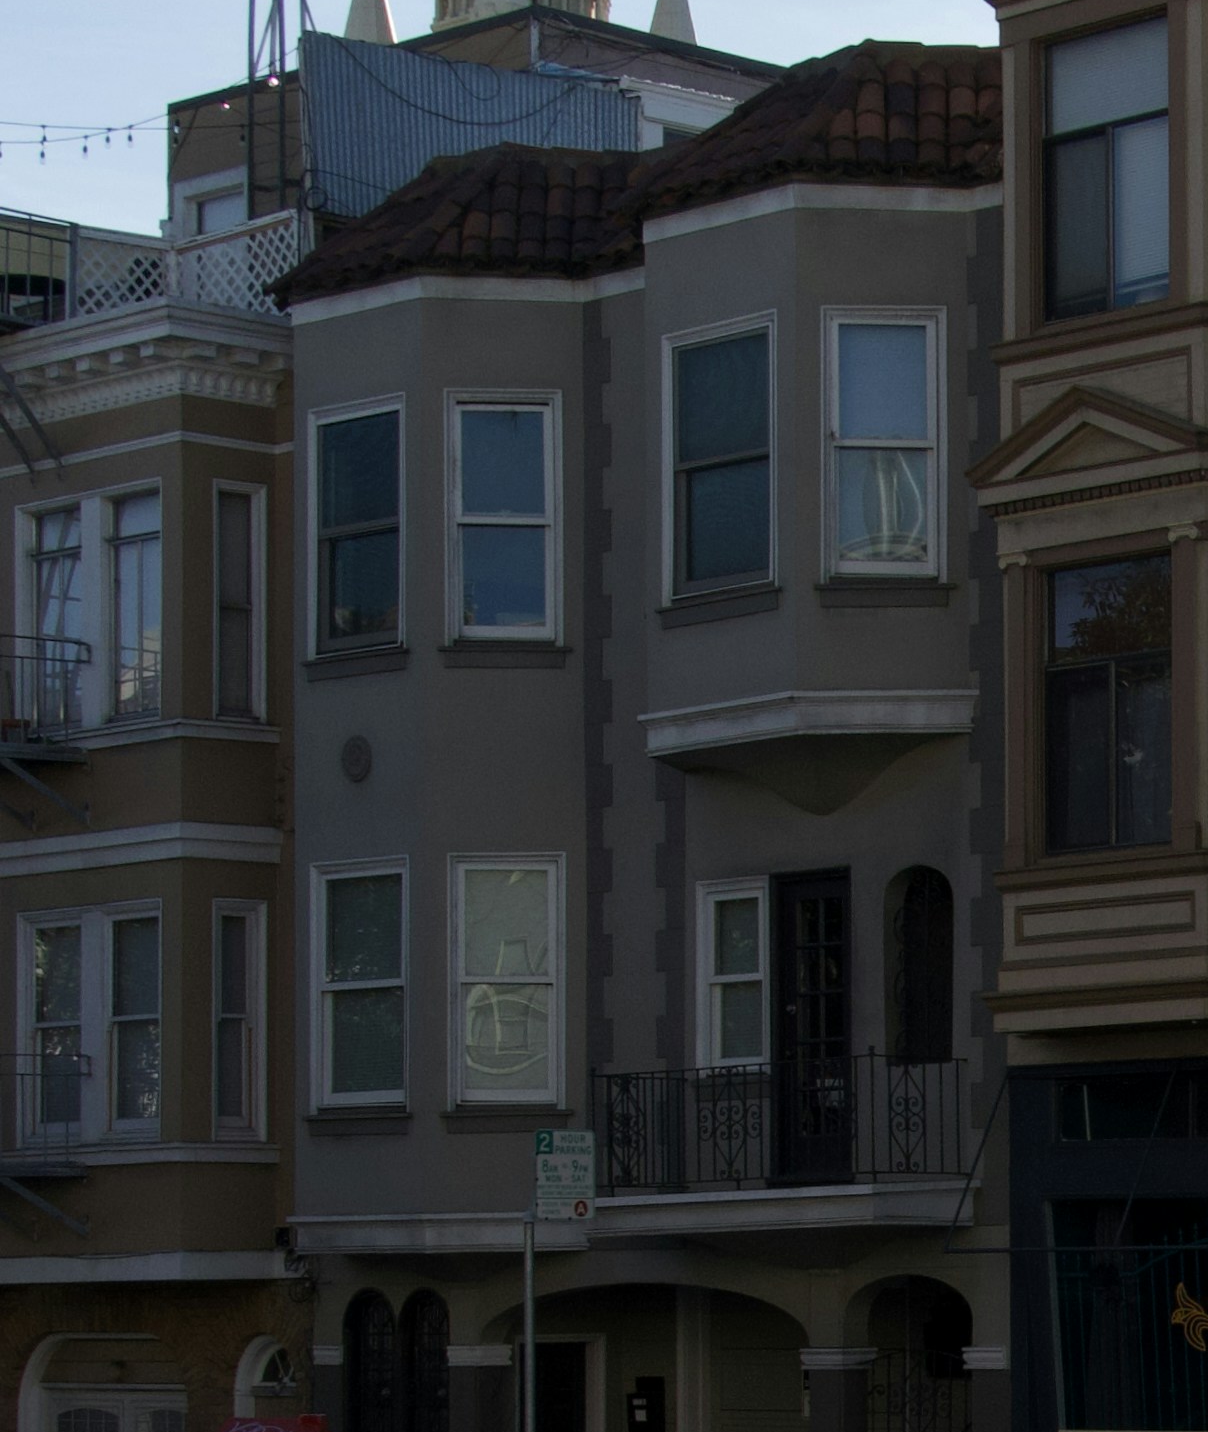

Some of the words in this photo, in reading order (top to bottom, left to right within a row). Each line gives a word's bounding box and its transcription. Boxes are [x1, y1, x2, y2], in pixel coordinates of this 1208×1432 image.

[539, 1133, 550, 1152] 2
[560, 1134, 586, 1144] HOUR
[555, 1145, 592, 1155] PARKING
[542, 1159, 558, 1173] 8AM
[572, 1159, 588, 1173] 9PM
[545, 1174, 562, 1183] MON
[572, 1174, 586, 1183] SAT
